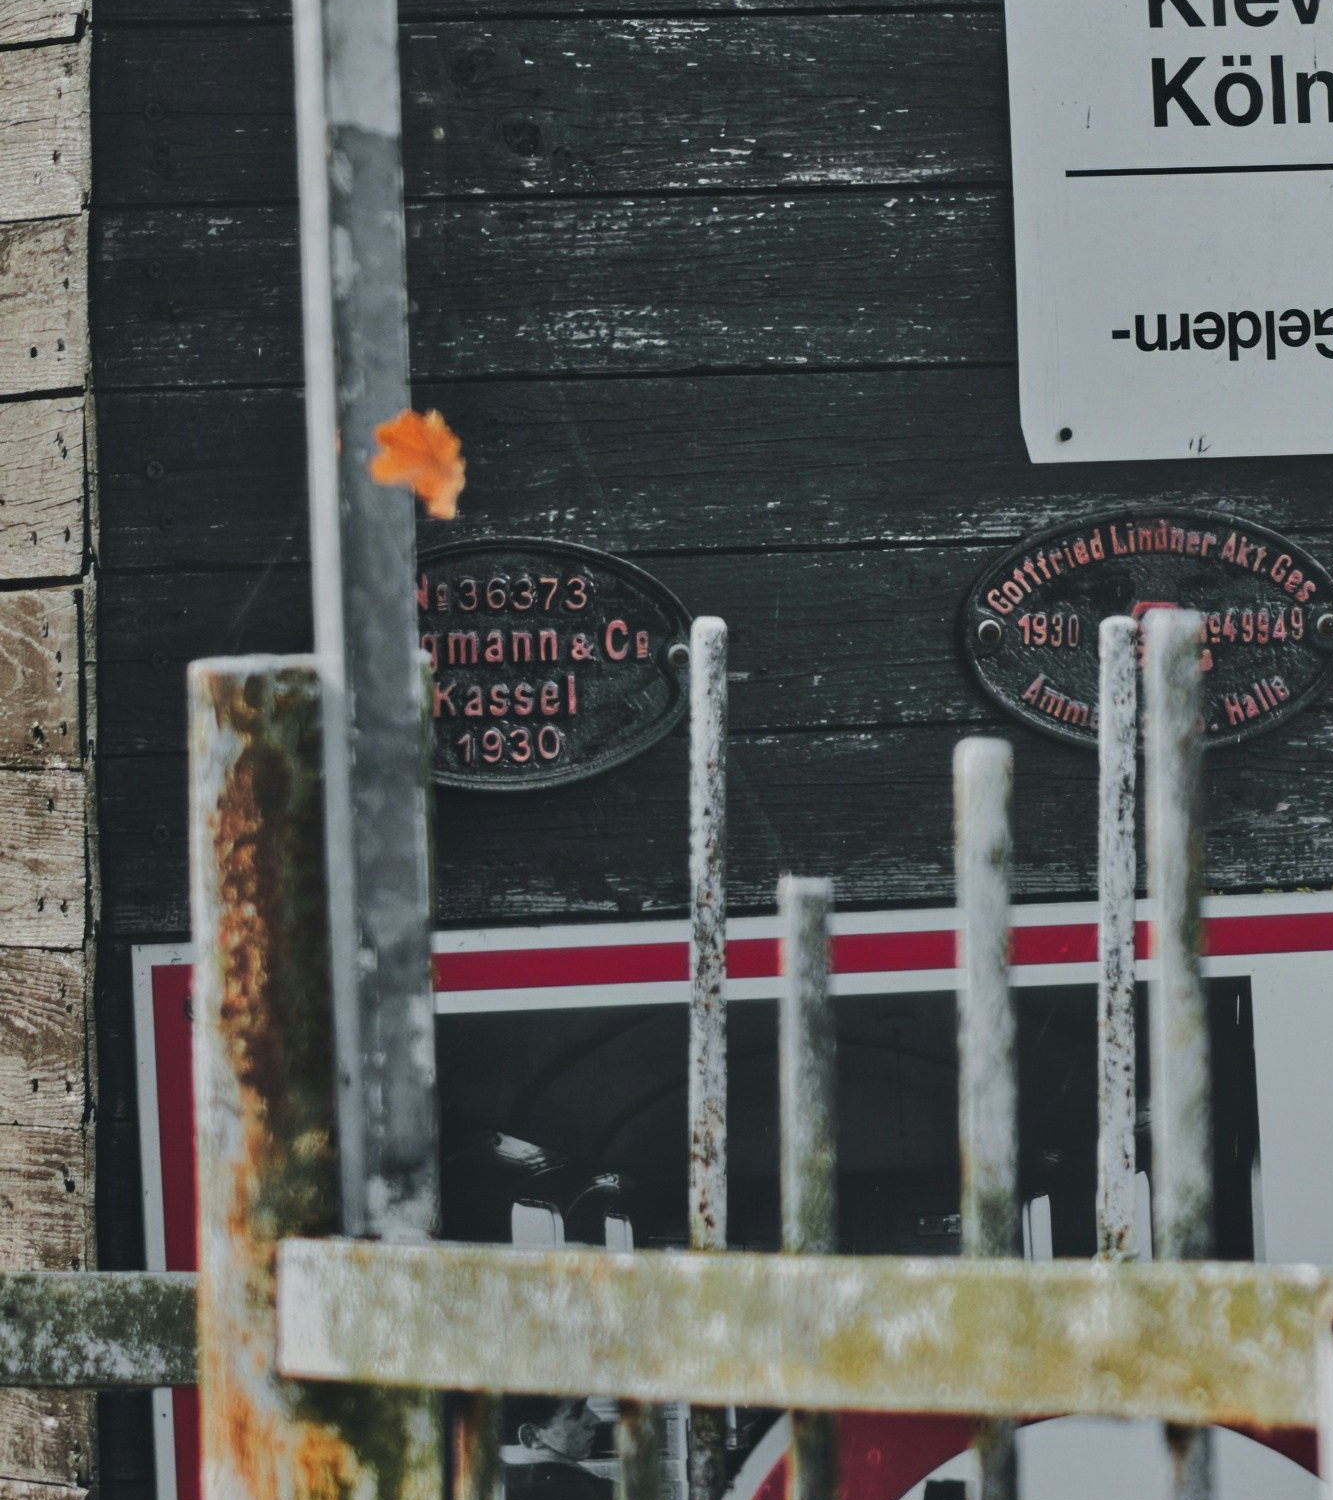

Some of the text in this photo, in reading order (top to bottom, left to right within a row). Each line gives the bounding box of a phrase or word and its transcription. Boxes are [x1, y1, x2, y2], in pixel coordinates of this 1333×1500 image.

[986, 527, 1105, 616] Gottfried
[1110, 518, 1218, 556] Lindner
[457, 575, 589, 613] 36373
[570, 632, 594, 661] &
[1017, 611, 1081, 648] 1930
[432, 671, 578, 719] Kassel
[457, 725, 561, 764] 1930
